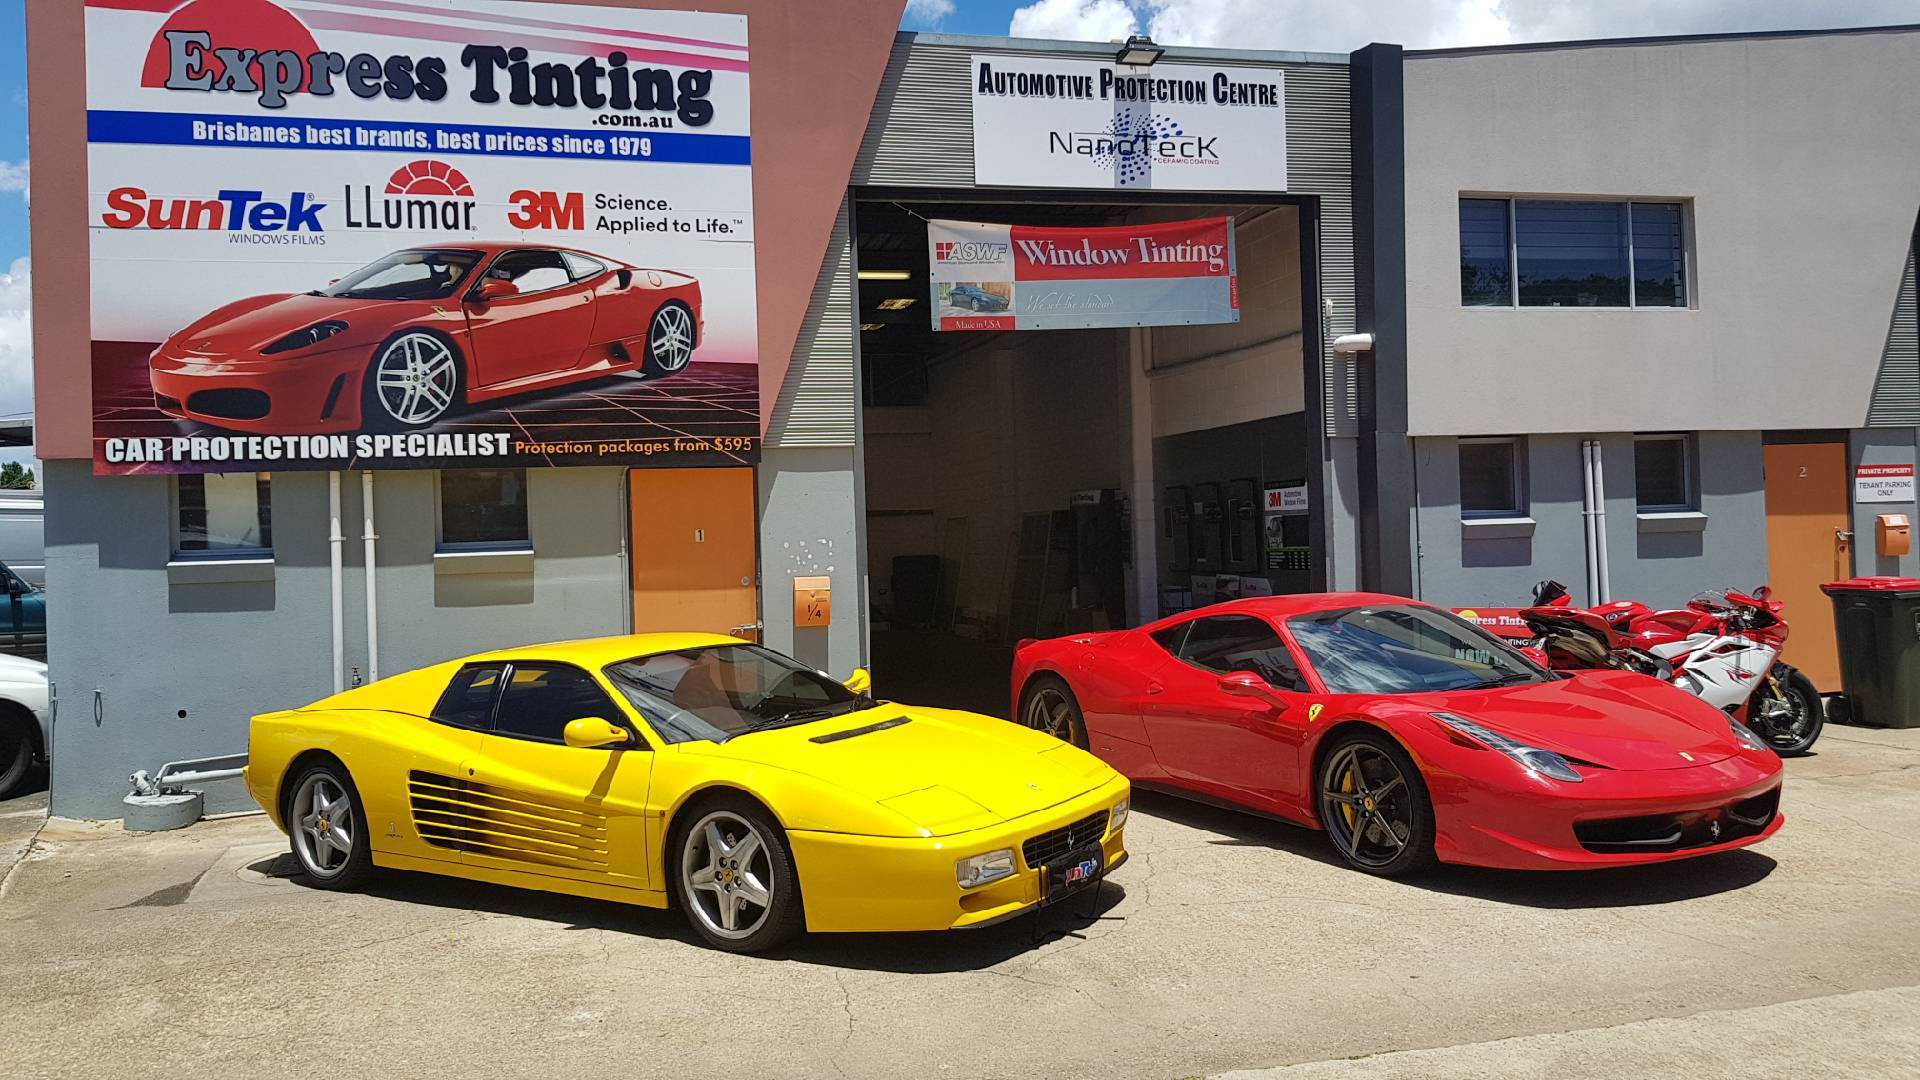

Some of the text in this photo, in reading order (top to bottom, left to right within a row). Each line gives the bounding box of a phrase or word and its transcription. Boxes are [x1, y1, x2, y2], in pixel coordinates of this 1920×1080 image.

[163, 29, 714, 126] Express Tinting
[978, 62, 1279, 106] AUTOMOTIVE PROTECTION CENTRE
[592, 114, 674, 129] .com.au
[192, 120, 652, 156] Brisbanes best brands, best prices since 1979
[507, 190, 585, 230] 3M
[594, 193, 672, 211] Science.
[596, 216, 667, 236] Applied
[673, 219, 691, 232] to
[229, 233, 326, 245] WINDOWS FILMS
[947, 242, 1008, 261] ASWF
[1015, 237, 1224, 272] Window Tinting
[984, 319, 1001, 329] USA
[105, 432, 752, 463] CAR PROTECTION SPECIALIST Protection packages from $595
[1799, 466, 1807, 477] 2
[1858, 480, 1912, 489] TENANT PARKING
[1268, 490, 1282, 508] 3M
[696, 529, 704, 541] 1
[807, 602, 821, 621] 1/4
